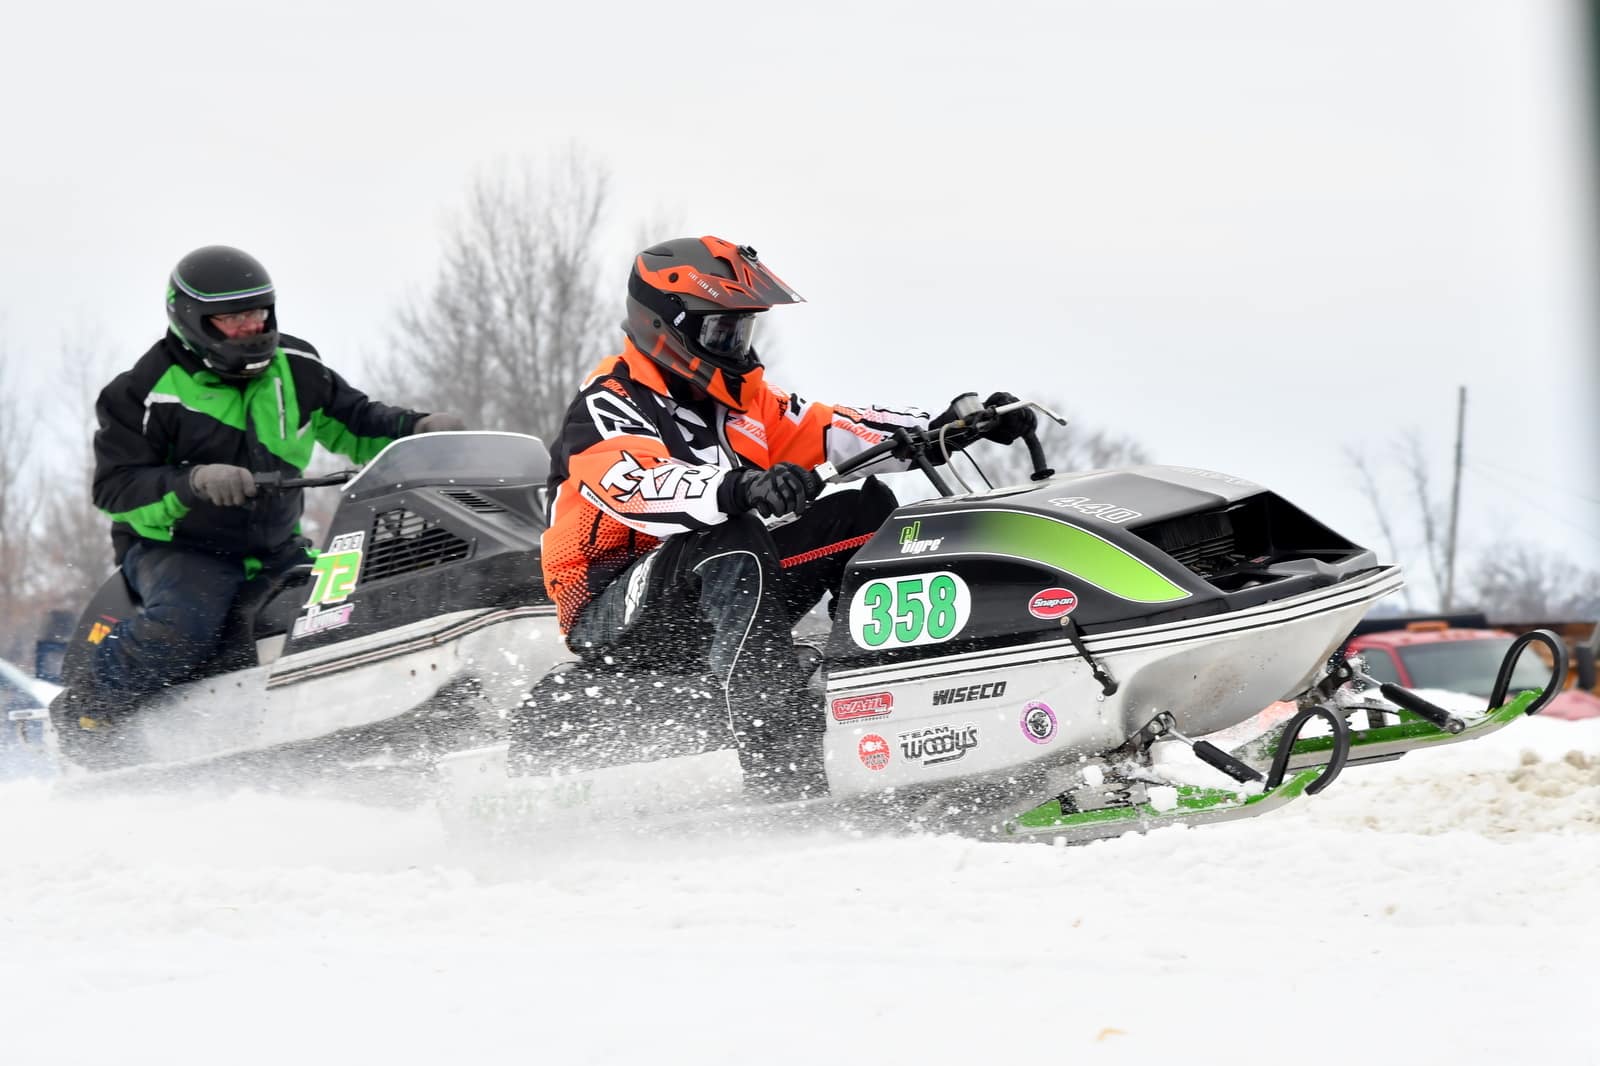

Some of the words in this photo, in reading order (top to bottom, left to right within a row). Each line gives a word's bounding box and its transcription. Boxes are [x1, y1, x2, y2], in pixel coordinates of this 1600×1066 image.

[599, 450, 720, 503] FXR
[1048, 496, 1142, 524] 440
[303, 550, 363, 609] 72
[862, 574, 957, 647] 358
[1032, 597, 1075, 608] Snap-on
[932, 681, 1007, 706] WISECO
[899, 726, 949, 741] TEAM
